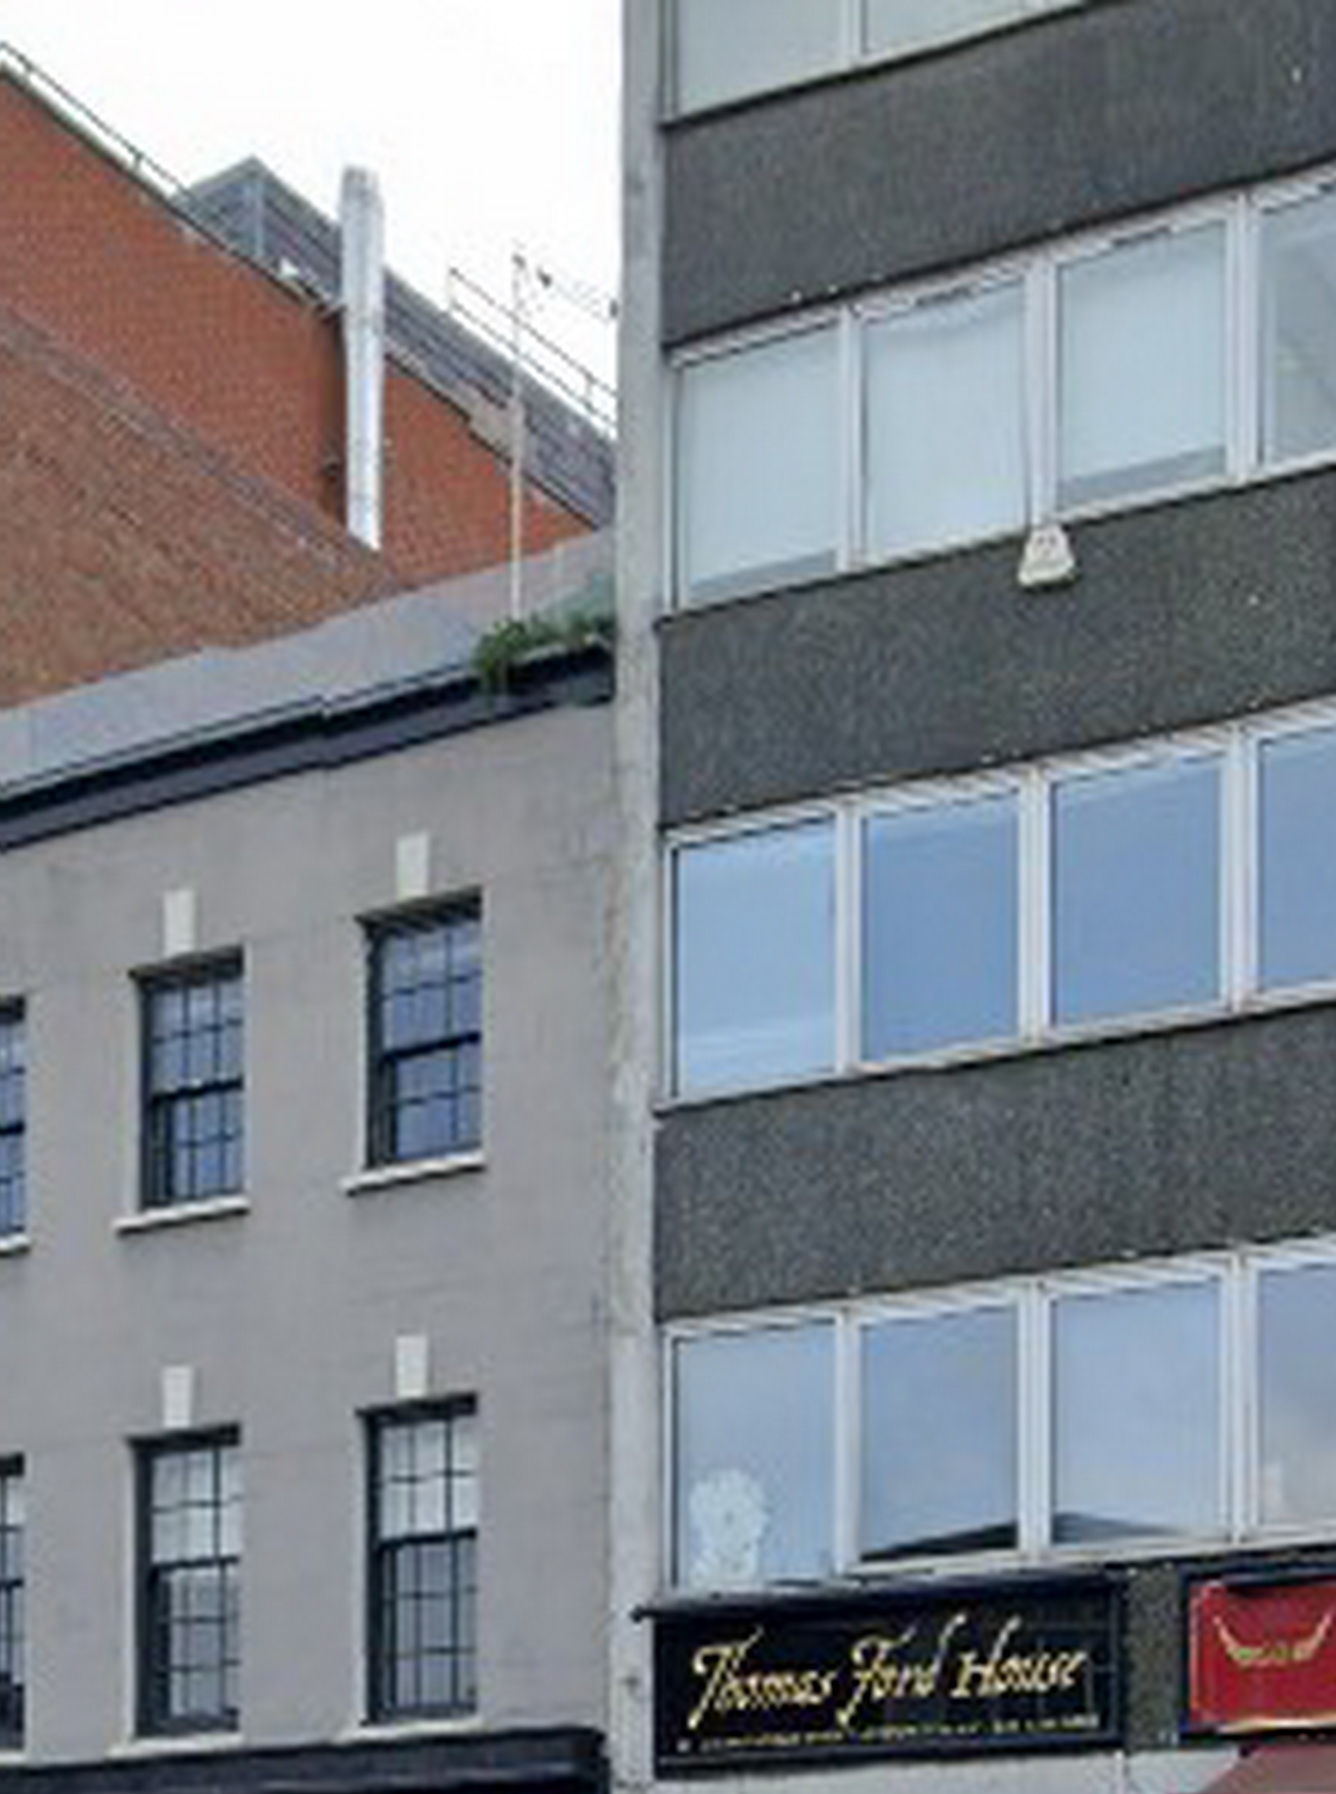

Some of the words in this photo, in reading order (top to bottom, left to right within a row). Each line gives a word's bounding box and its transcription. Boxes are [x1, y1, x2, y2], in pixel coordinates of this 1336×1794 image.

[687, 1624, 839, 1731] Thomas
[836, 1612, 967, 1728] Ford
[950, 1615, 1089, 1699] House
